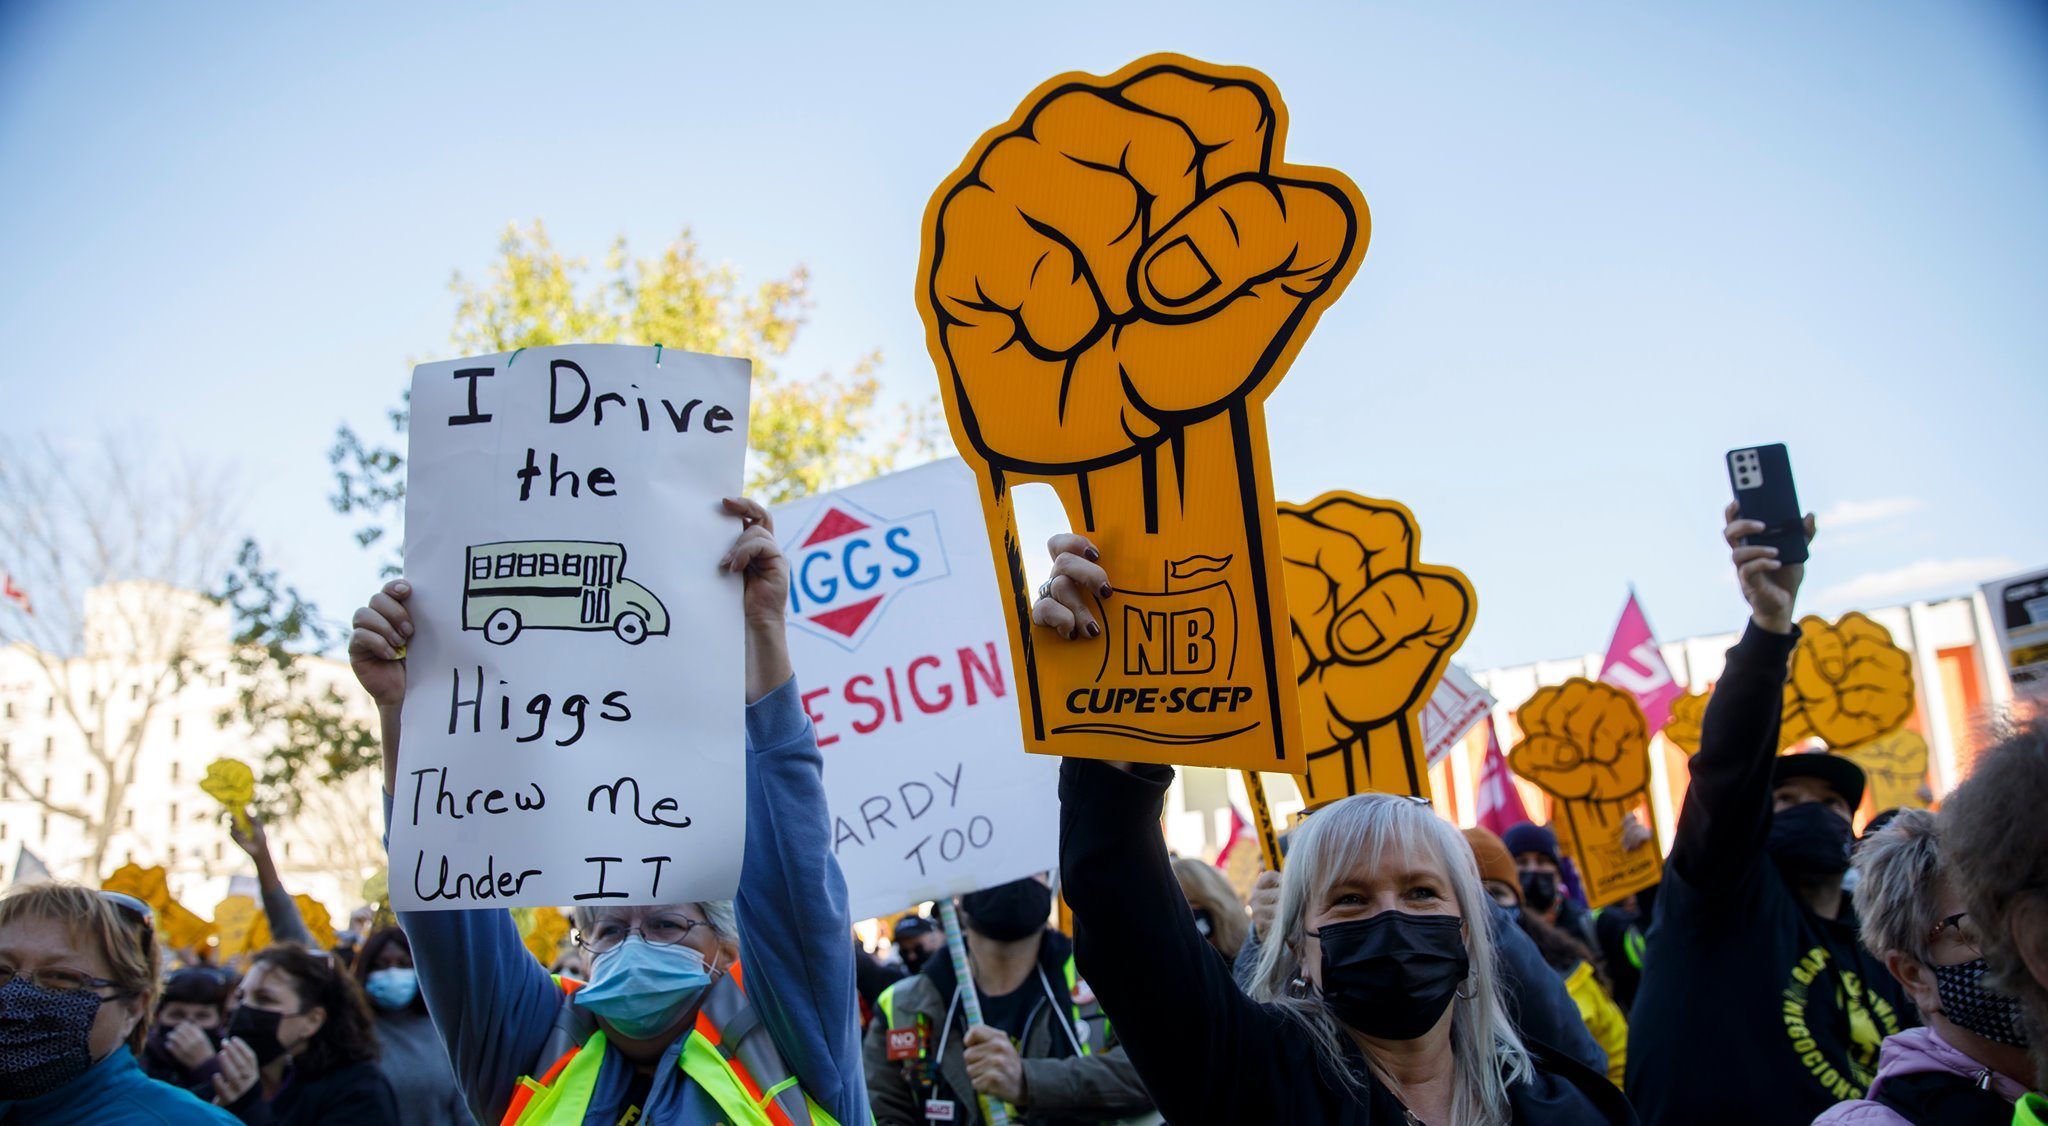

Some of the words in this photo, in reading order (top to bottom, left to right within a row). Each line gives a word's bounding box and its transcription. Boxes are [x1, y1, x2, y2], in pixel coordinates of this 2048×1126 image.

[448, 367, 495, 426] I
[549, 359, 734, 433] Drive
[517, 448, 618, 501] the
[788, 526, 921, 614] IGGS
[1124, 604, 1216, 675] NB
[448, 665, 632, 747] Higgs
[801, 641, 1008, 748] ESIGN
[411, 766, 546, 826] Threw
[832, 762, 963, 855] ARDY
[414, 849, 543, 902] Under
[904, 815, 994, 876] TOO
